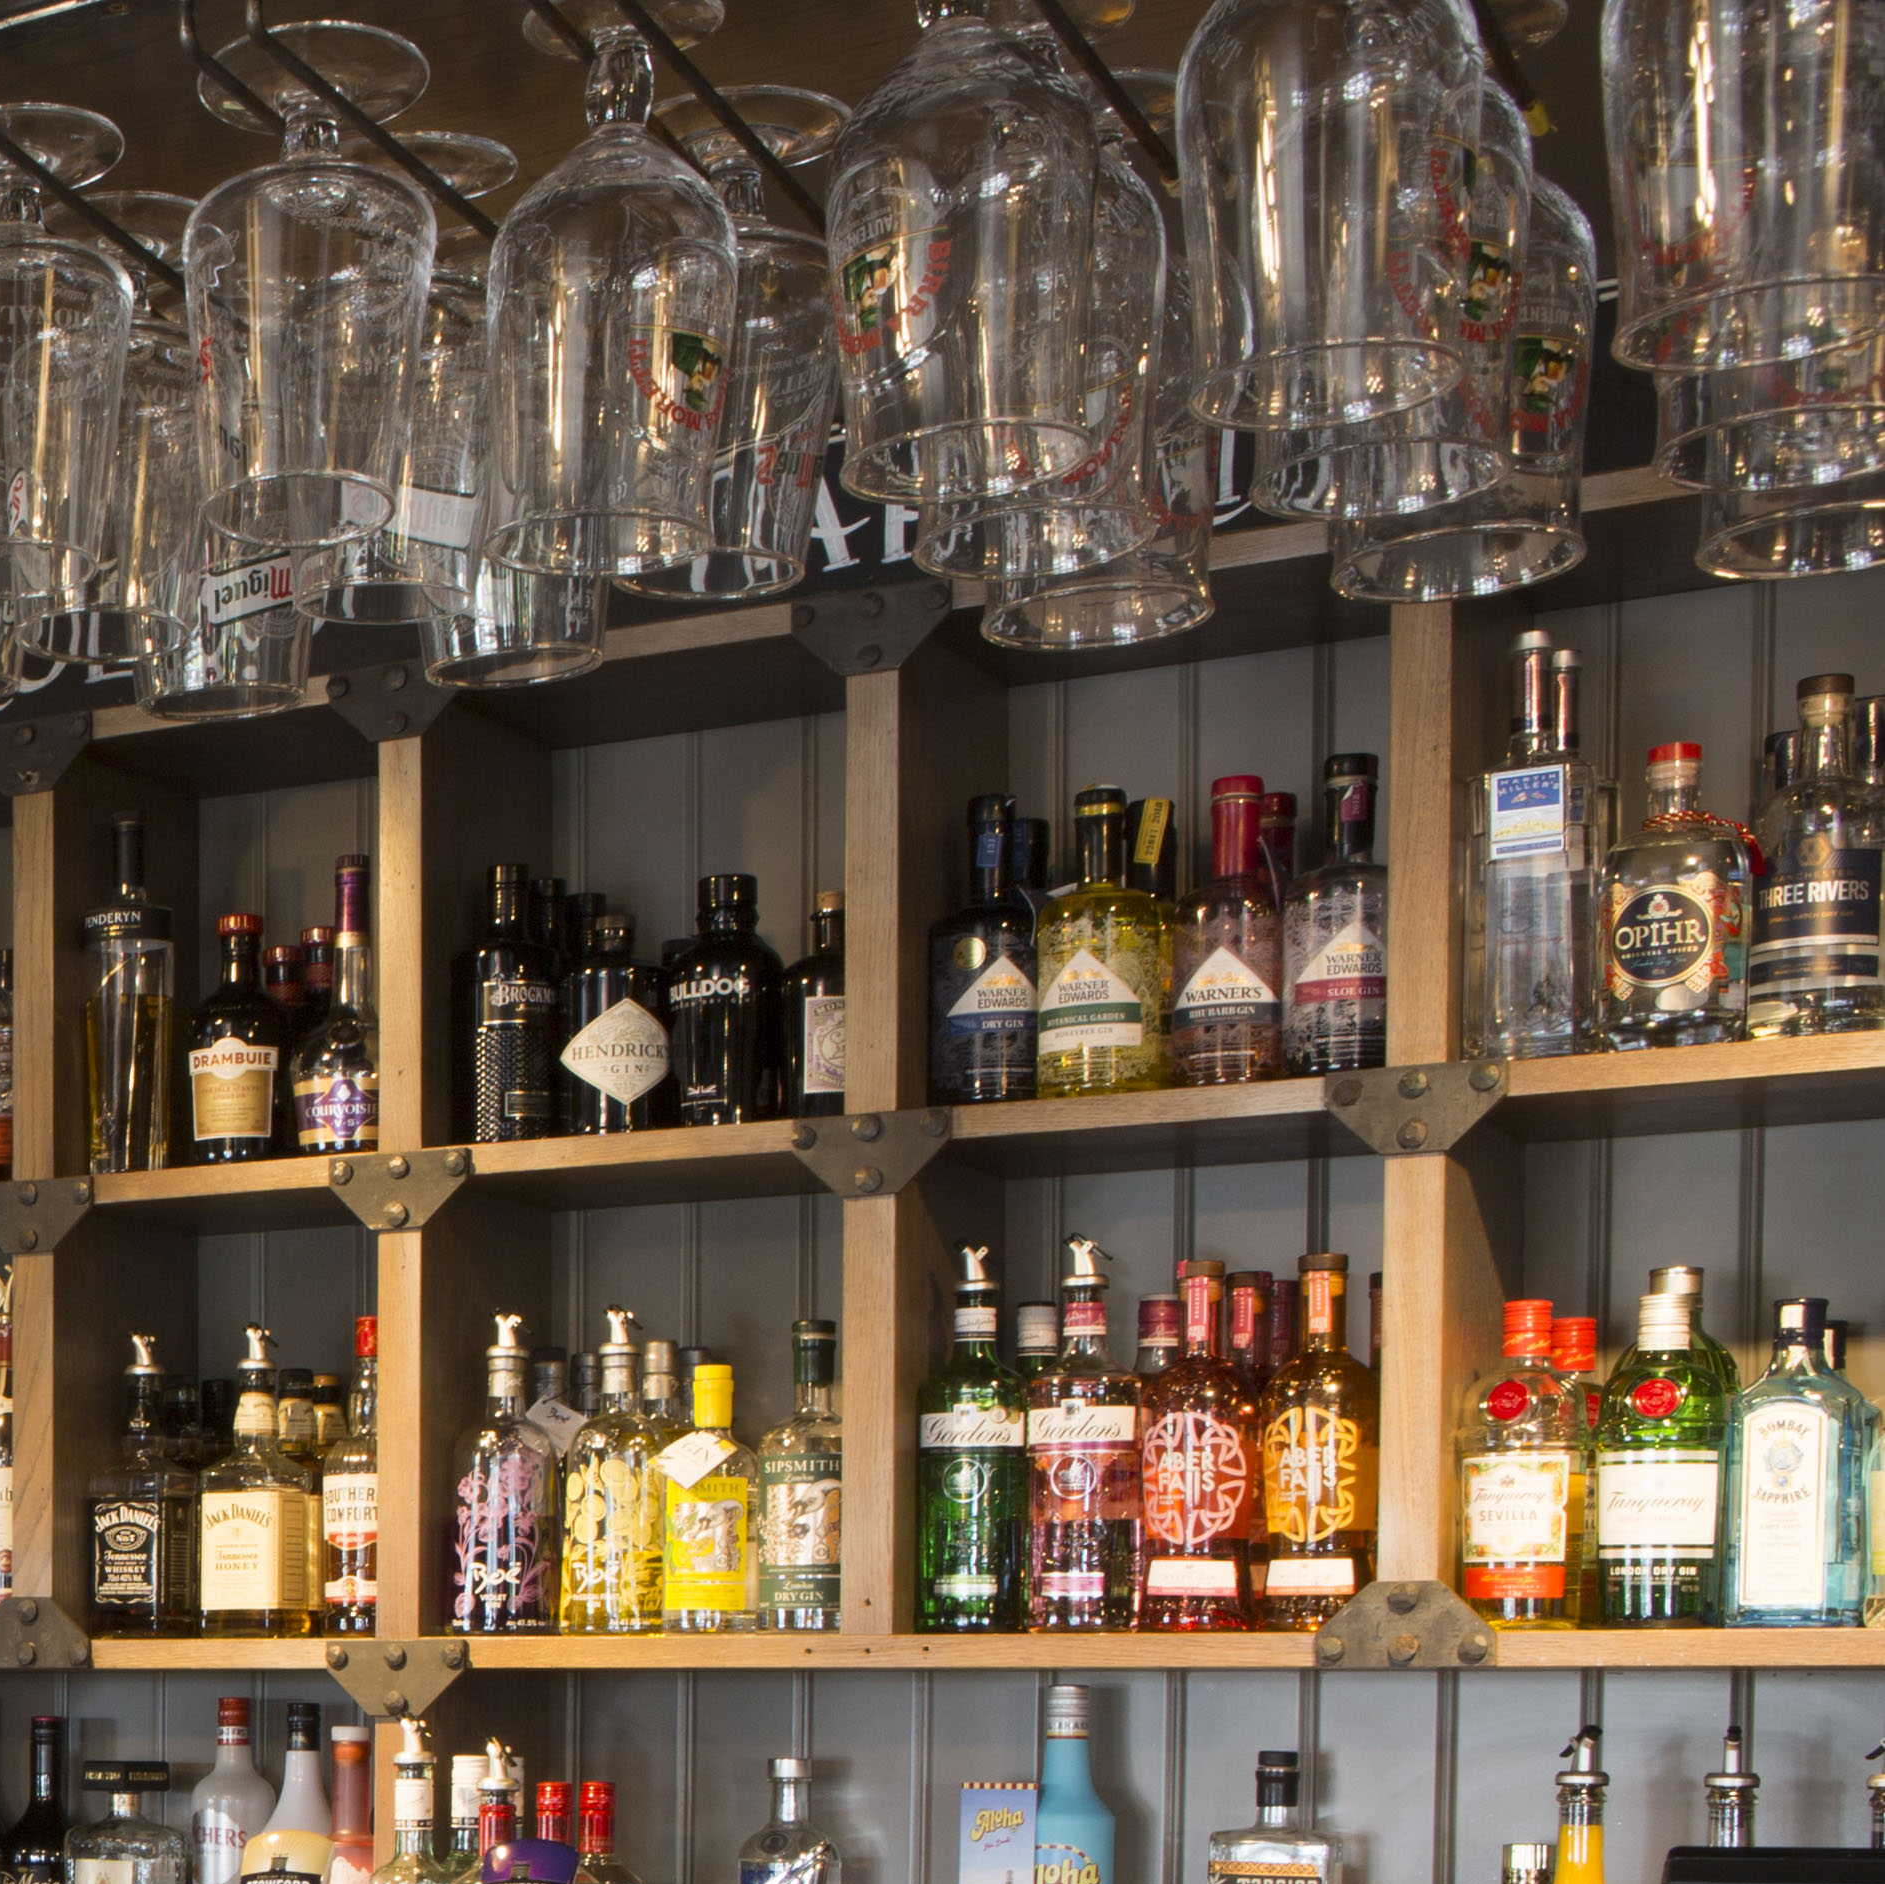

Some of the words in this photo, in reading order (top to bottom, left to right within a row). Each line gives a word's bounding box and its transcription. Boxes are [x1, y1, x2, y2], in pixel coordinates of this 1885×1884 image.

[214, 565, 292, 614] Miguel
[1759, 880, 1804, 910] THREE
[1807, 879, 1869, 903] RIVERS
[1614, 918, 1707, 950] OPIHR
[1324, 950, 1382, 966] WARNER
[1326, 961, 1383, 976] EDWARDS
[670, 977, 751, 1003] BULLDOG
[977, 987, 1028, 999] WARNER
[1056, 979, 1110, 994] WARNER
[1184, 986, 1263, 1002] WARNER'S
[1326, 986, 1357, 998] SLOE
[1359, 985, 1381, 996] GIN
[978, 997, 1028, 1009] EDWARDS
[1058, 989, 1110, 1002] EDWARDS
[1233, 1004, 1256, 1016] GIN
[981, 1019, 1001, 1030] DRY
[1003, 1018, 1025, 1029] GIN
[1047, 1012, 1088, 1027] BOTANICAL
[1090, 1011, 1126, 1023] GARDEN
[192, 1051, 272, 1069] DRAMBUIE
[610, 1064, 644, 1074] GIN
[924, 1417, 1011, 1445] Gordon's
[1034, 1413, 1122, 1440] Gordon's
[1757, 1419, 1812, 1438] BOMBAY
[1159, 1452, 1215, 1472] ABER
[1280, 1447, 1337, 1468] ABER
[764, 1460, 840, 1474] SIPSMITH
[1473, 1486, 1549, 1507] Tanqueray
[1607, 1491, 1706, 1515] Tanqueray
[1755, 1486, 1812, 1505] SAPPHIRE
[95, 1513, 119, 1532] JACK
[120, 1505, 161, 1532] DANIEL'S
[205, 1511, 229, 1530] JACK
[231, 1503, 273, 1529] DANIEL'S
[326, 1506, 378, 1523] COMFORT
[1479, 1509, 1538, 1522] SEVILLA
[104, 1550, 148, 1561] Tennessee
[215, 1551, 258, 1560] Tennessee
[105, 1565, 147, 1573] WHISKEY
[215, 1562, 259, 1571] HONEY
[1610, 1566, 1650, 1577] LONDON
[1653, 1566, 1676, 1577] DRY
[1679, 1566, 1698, 1577] GIN
[469, 1561, 523, 1595] Boë
[571, 1561, 620, 1594] Boë
[478, 1593, 508, 1602] VIOLET
[774, 1590, 799, 1602] DRY
[799, 1591, 824, 1602] GIN
[969, 1807, 1025, 1843] Aloha
